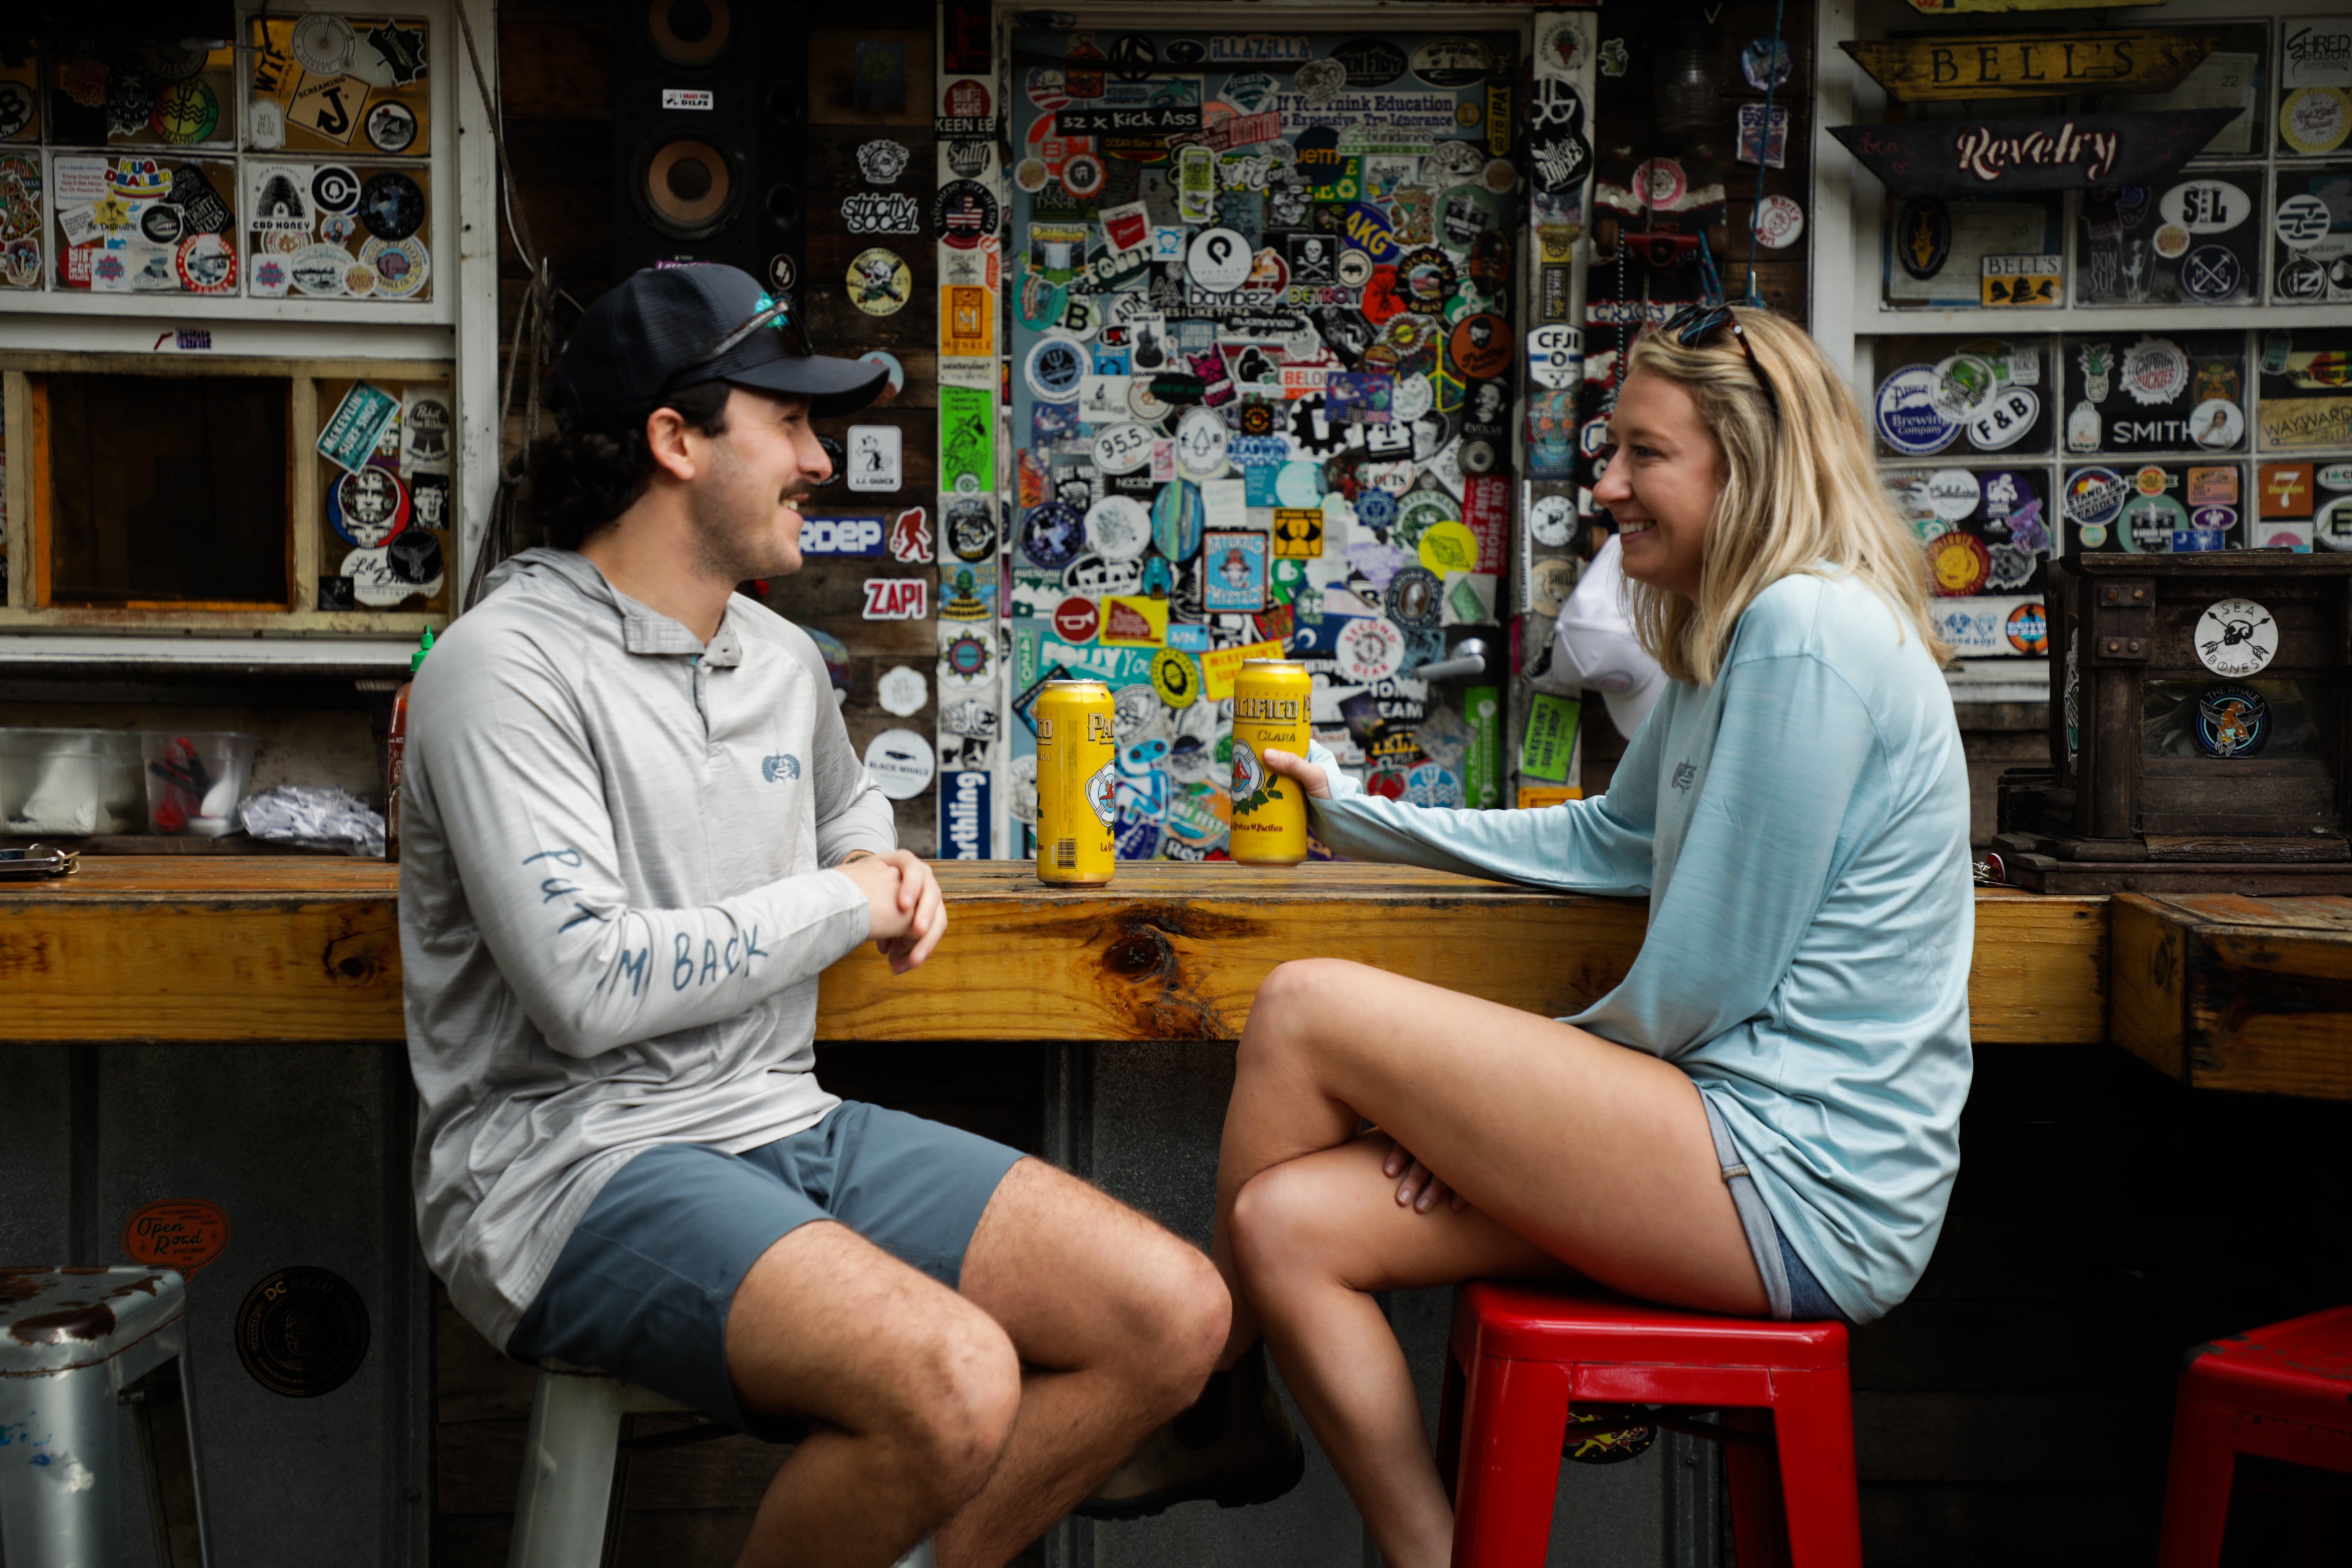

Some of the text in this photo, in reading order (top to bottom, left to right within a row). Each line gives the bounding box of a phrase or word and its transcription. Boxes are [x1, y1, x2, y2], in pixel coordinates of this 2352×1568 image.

[1931, 40, 2133, 83] BELL'S
[298, 75, 346, 99] SCREAMING
[2222, 75, 2239, 87] 22
[1276, 96, 1289, 111] If
[1375, 96, 1453, 111] Education
[1493, 87, 1506, 118] IPA
[934, 118, 968, 132] KEEN
[1063, 116, 1087, 129] 32
[1113, 111, 1156, 127] Kick
[1161, 111, 1197, 126] Ass
[1390, 113, 1453, 127] Ignorance
[1105, 138, 1132, 148] OCEAN
[1956, 123, 2118, 181] Revelry
[121, 160, 156, 174] HUG
[104, 169, 172, 186] DEALER
[252, 220, 310, 230] CBD HONEY
[1988, 257, 2059, 275] BELL'S
[1289, 287, 1363, 305] DETROIT
[959, 309, 978, 331] M
[2135, 353, 2174, 373] CAPTAIN
[1464, 422, 1504, 434] EVOLVE
[1898, 426, 1942, 437] Company
[1100, 428, 1144, 458] 95.5
[1485, 480, 1506, 569] ON SHORE
[869, 584, 923, 613] ZAP!
[2221, 601, 2255, 615] SEA
[1041, 641, 1123, 679] FOLLY
[2206, 685, 2261, 703] THE WHALE
[1257, 729, 1296, 742] CLARA
[869, 761, 930, 777] BLACK WHALE
[672, 924, 769, 992] BACK
[136, 1216, 186, 1238] Open
[153, 1229, 204, 1256] Road
[263, 1277, 335, 1302] DC BRAU
